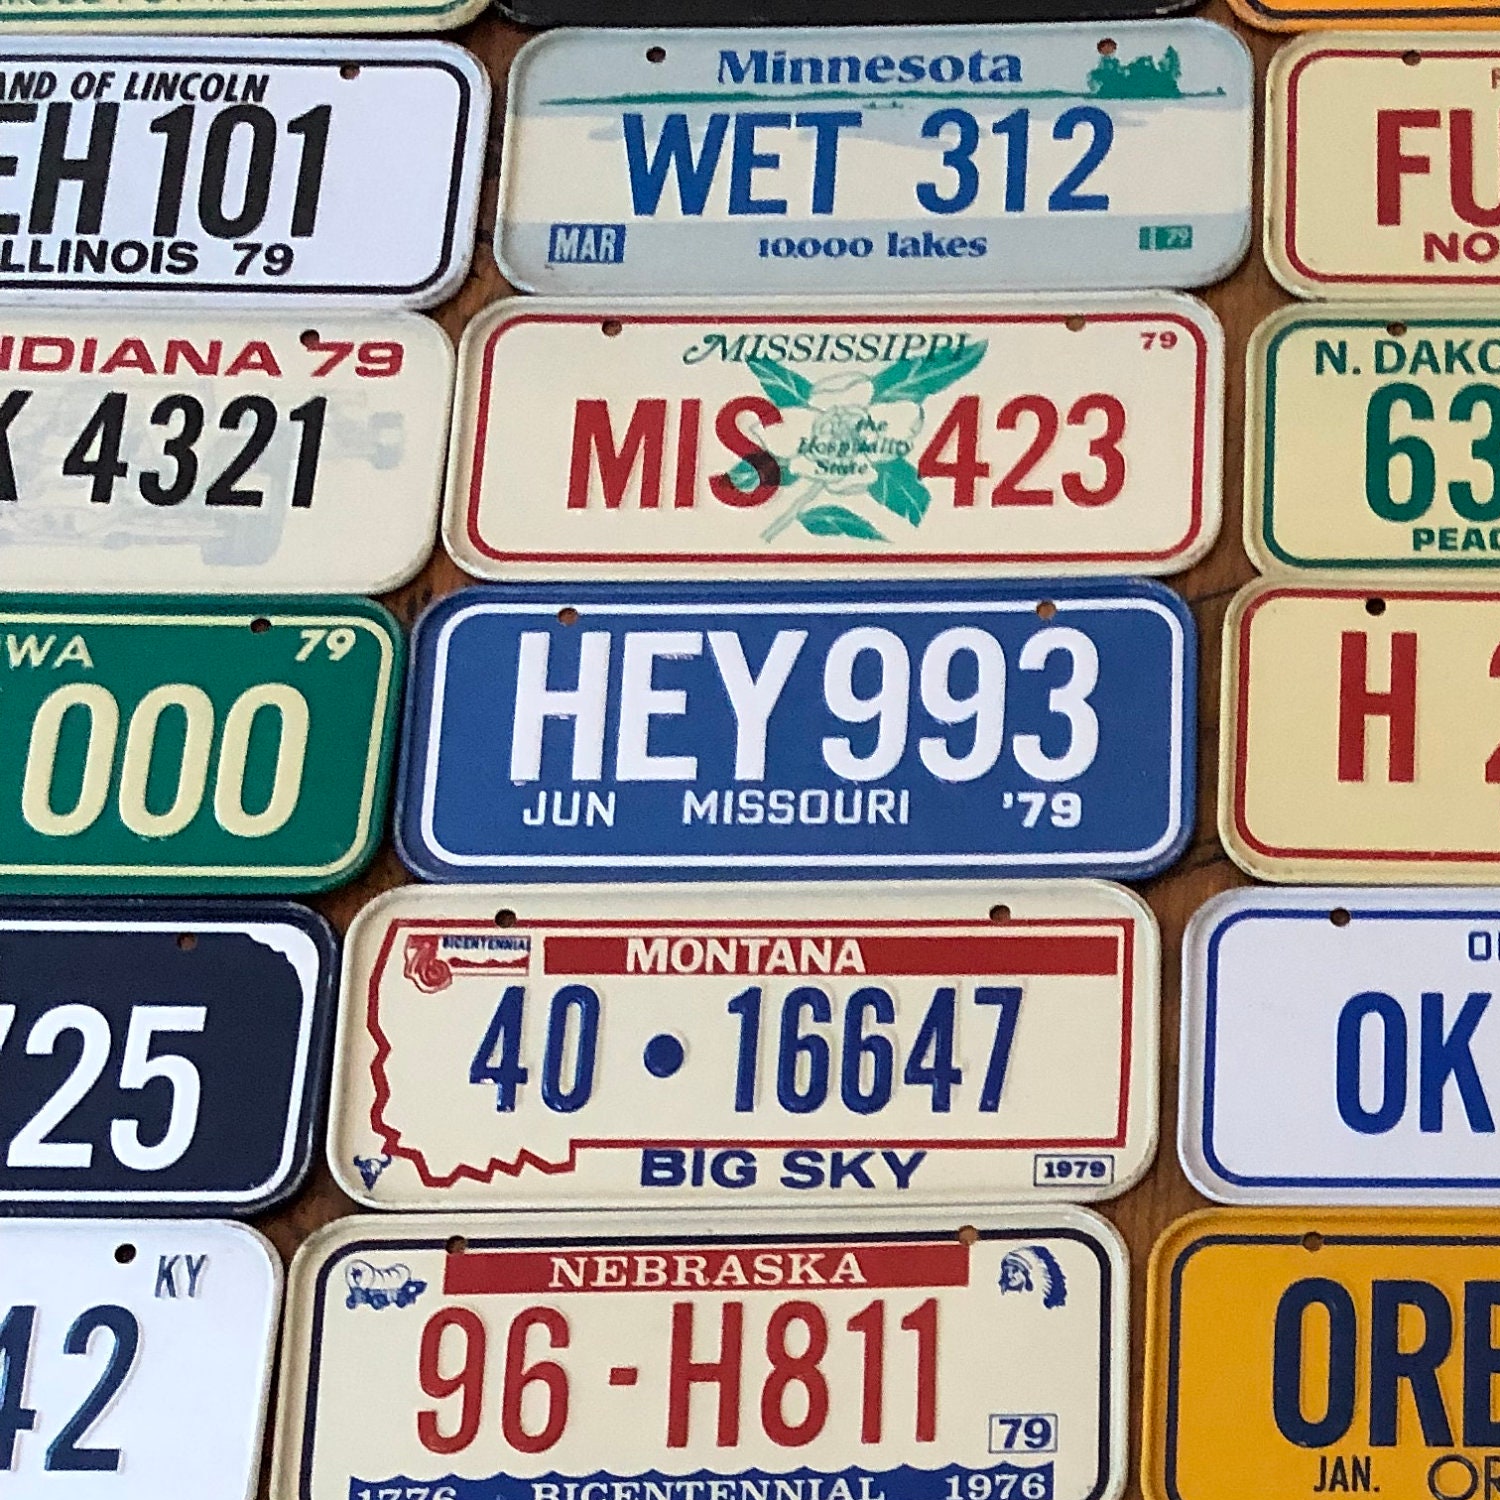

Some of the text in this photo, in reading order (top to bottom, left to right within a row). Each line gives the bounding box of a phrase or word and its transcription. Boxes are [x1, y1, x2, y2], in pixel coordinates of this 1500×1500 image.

[718, 50, 1022, 84] Minnesota
[71, 71, 269, 102] OF LINCOLN
[150, 104, 332, 239] 101
[623, 106, 1114, 217] WET 312
[233, 243, 294, 276] 79
[554, 226, 616, 262] MAR
[887, 231, 987, 258] lakes
[682, 334, 971, 365] MISSISSIPPI
[1140, 333, 1178, 349] 79
[1315, 340, 1361, 376] N.
[62, 391, 329, 508] 4321
[566, 395, 1127, 510] MIS 423
[296, 628, 357, 663] 79
[510, 626, 1100, 785] HEY 993
[1337, 631, 1418, 783] H
[22, 683, 311, 838] 000
[522, 790, 616, 827] JUN
[682, 788, 910, 826] MISSOURI
[626, 938, 866, 974] MONTANA
[469, 983, 1024, 1115] 40 16647
[1336, 990, 1495, 1135] OK
[641, 1149, 927, 1189] BIG SKY
[1044, 1161, 1105, 1179] 1979
[155, 1255, 208, 1298] KY
[549, 1254, 866, 1289] NEBRASKA
[999, 1419, 1052, 1448] 79
[944, 1473, 1046, 1500] 1976
[1314, 1456, 1380, 1492] JAN.
